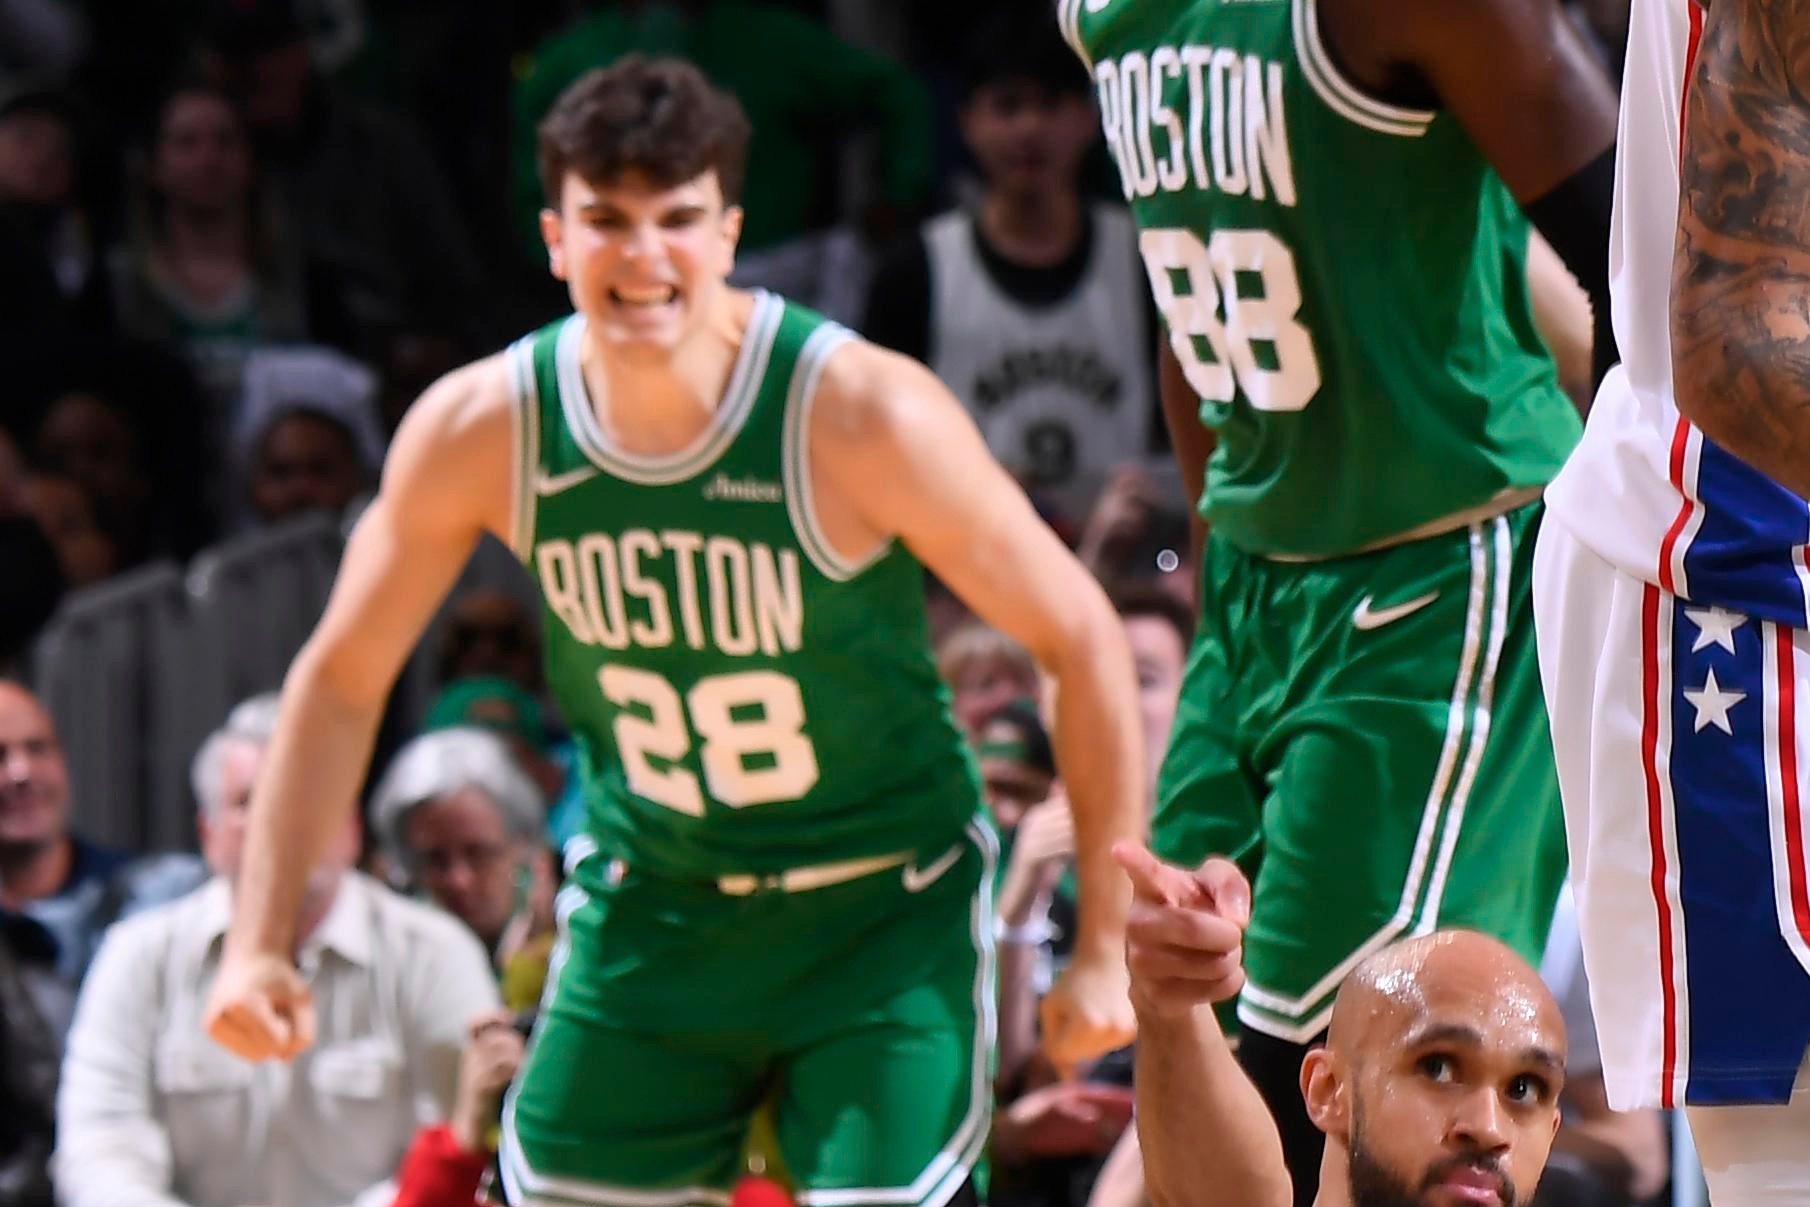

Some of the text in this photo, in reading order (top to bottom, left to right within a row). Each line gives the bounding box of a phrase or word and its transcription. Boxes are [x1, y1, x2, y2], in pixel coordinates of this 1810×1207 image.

[1096, 45, 1297, 207] BOSTON
[1138, 228, 1322, 411] 88
[537, 528, 804, 657] BOSTON
[598, 663, 821, 817] 28
